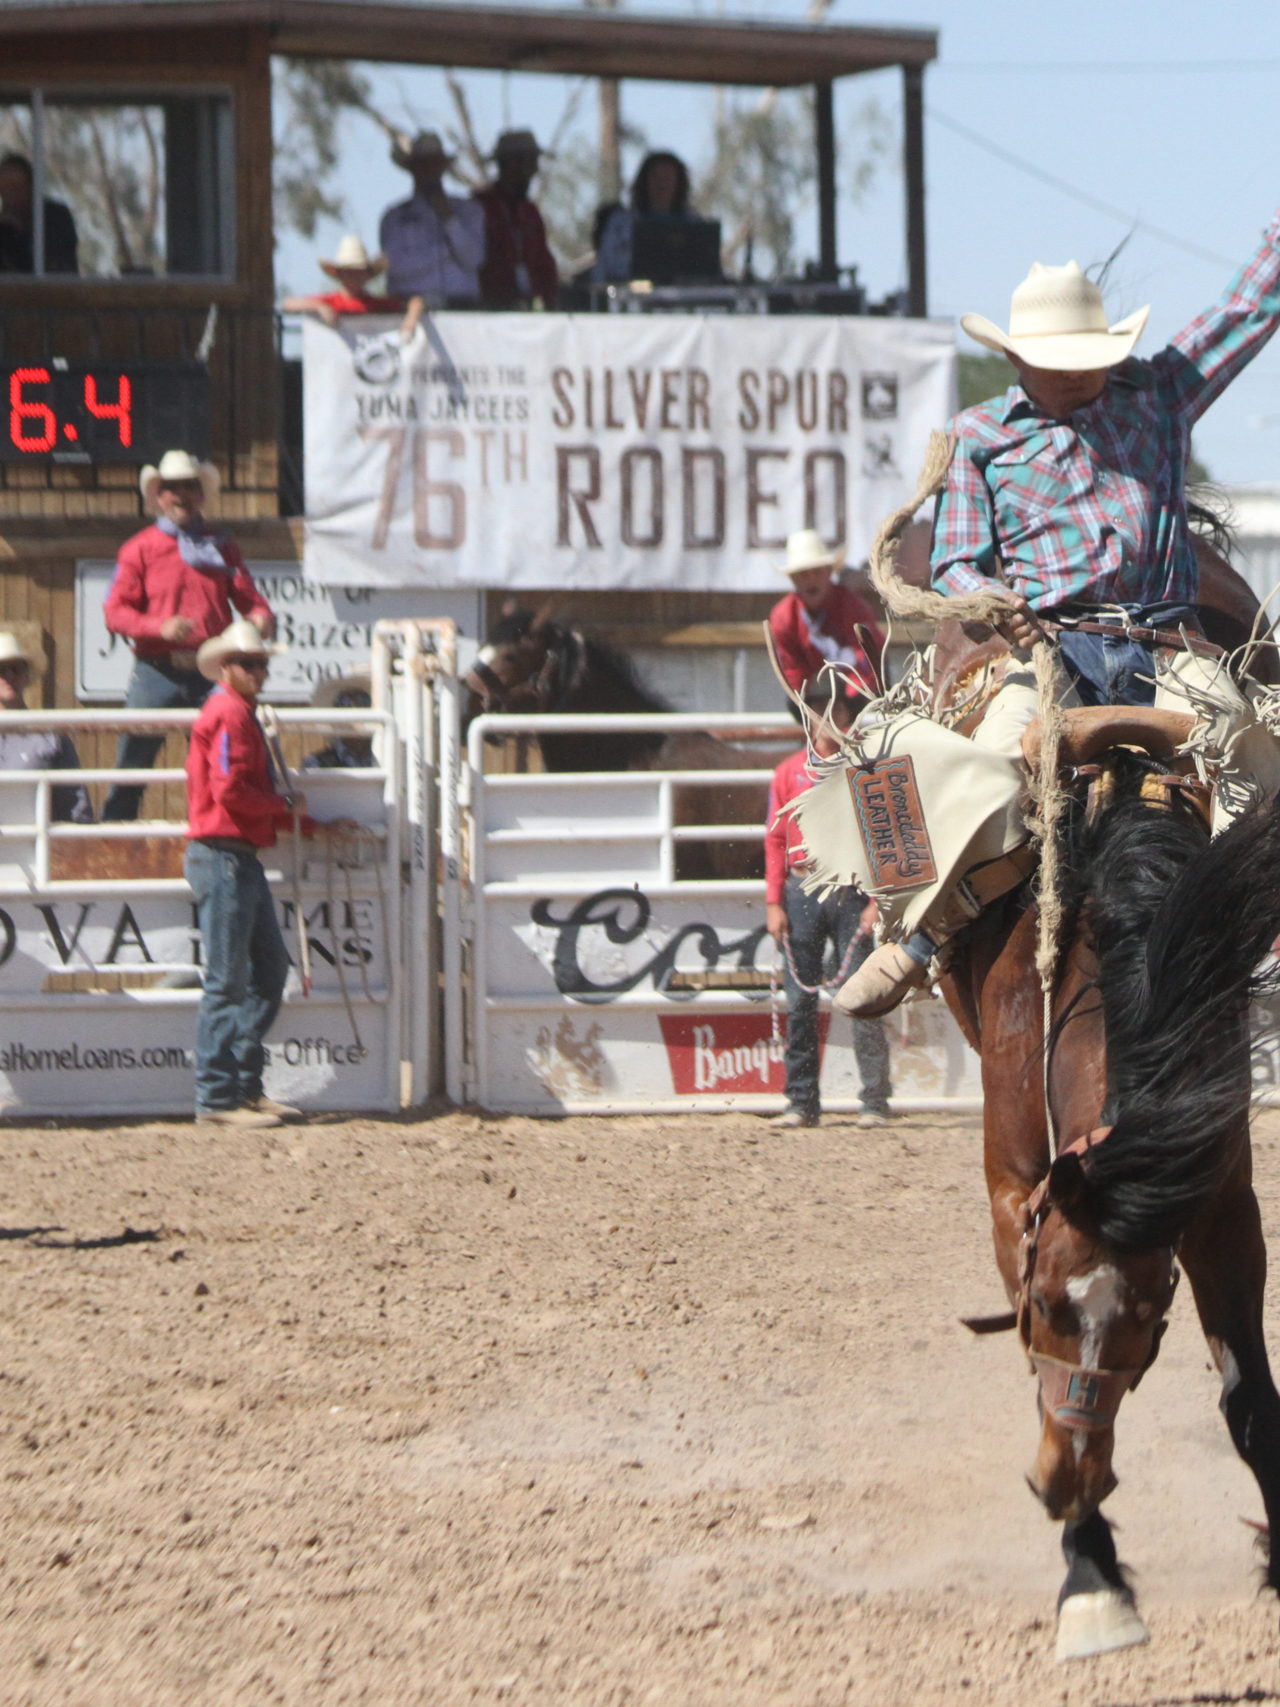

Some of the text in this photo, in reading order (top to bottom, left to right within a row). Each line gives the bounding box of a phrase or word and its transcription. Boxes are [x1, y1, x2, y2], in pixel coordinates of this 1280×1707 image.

[10, 368, 132, 451] 6.4
[355, 394, 530, 423] YUMA JAYCEES
[552, 366, 711, 430] SILVER
[738, 367, 849, 433] SPUR
[555, 444, 847, 550] RODEO
[863, 779, 898, 866] LEATHER
